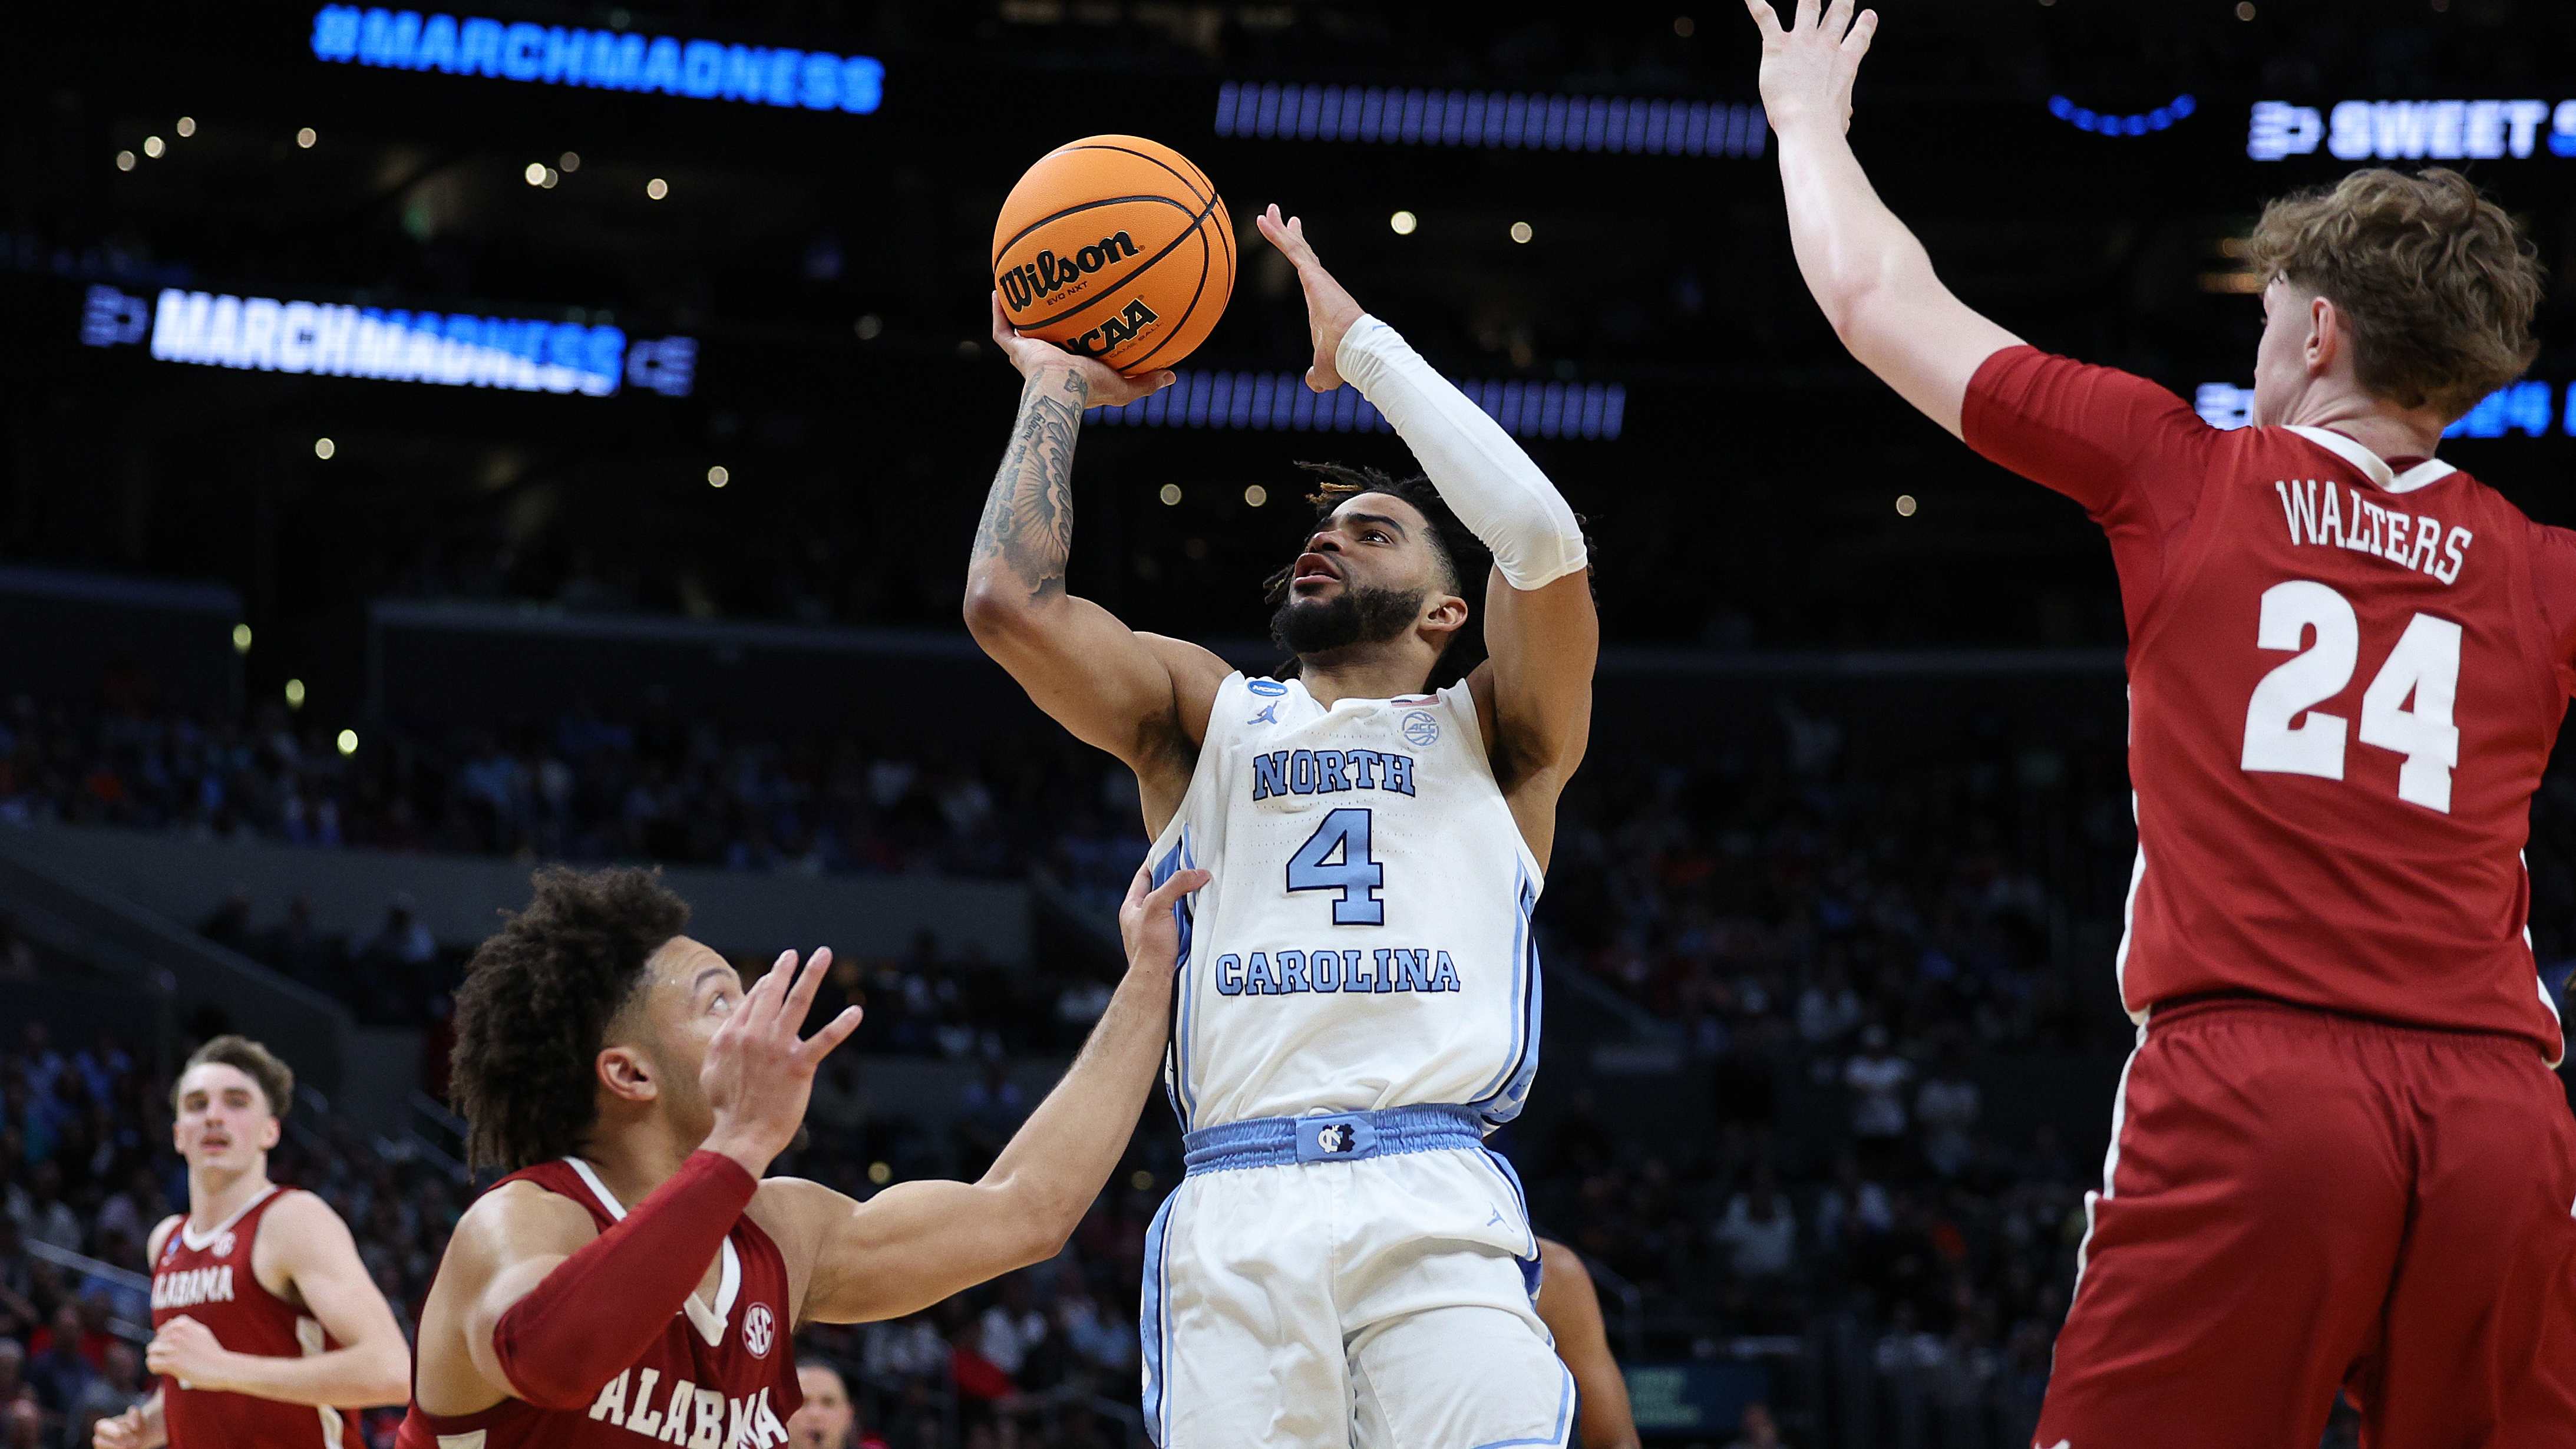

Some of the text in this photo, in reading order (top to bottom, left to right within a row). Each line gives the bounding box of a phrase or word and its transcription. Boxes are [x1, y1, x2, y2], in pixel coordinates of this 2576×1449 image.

[312, 4, 884, 114] #MARCHMADNESS
[2327, 99, 2549, 160] SWEET
[999, 230, 1139, 312] Wilson
[1046, 280, 1088, 306] EVO NXT
[2276, 479, 2473, 585] WALTERS
[2241, 580, 2463, 814] 24
[1253, 749, 1415, 801] NORTH
[1286, 808, 1384, 926] 4
[1216, 949, 1461, 996] CAROLINA
[745, 1306, 772, 1355] SEC
